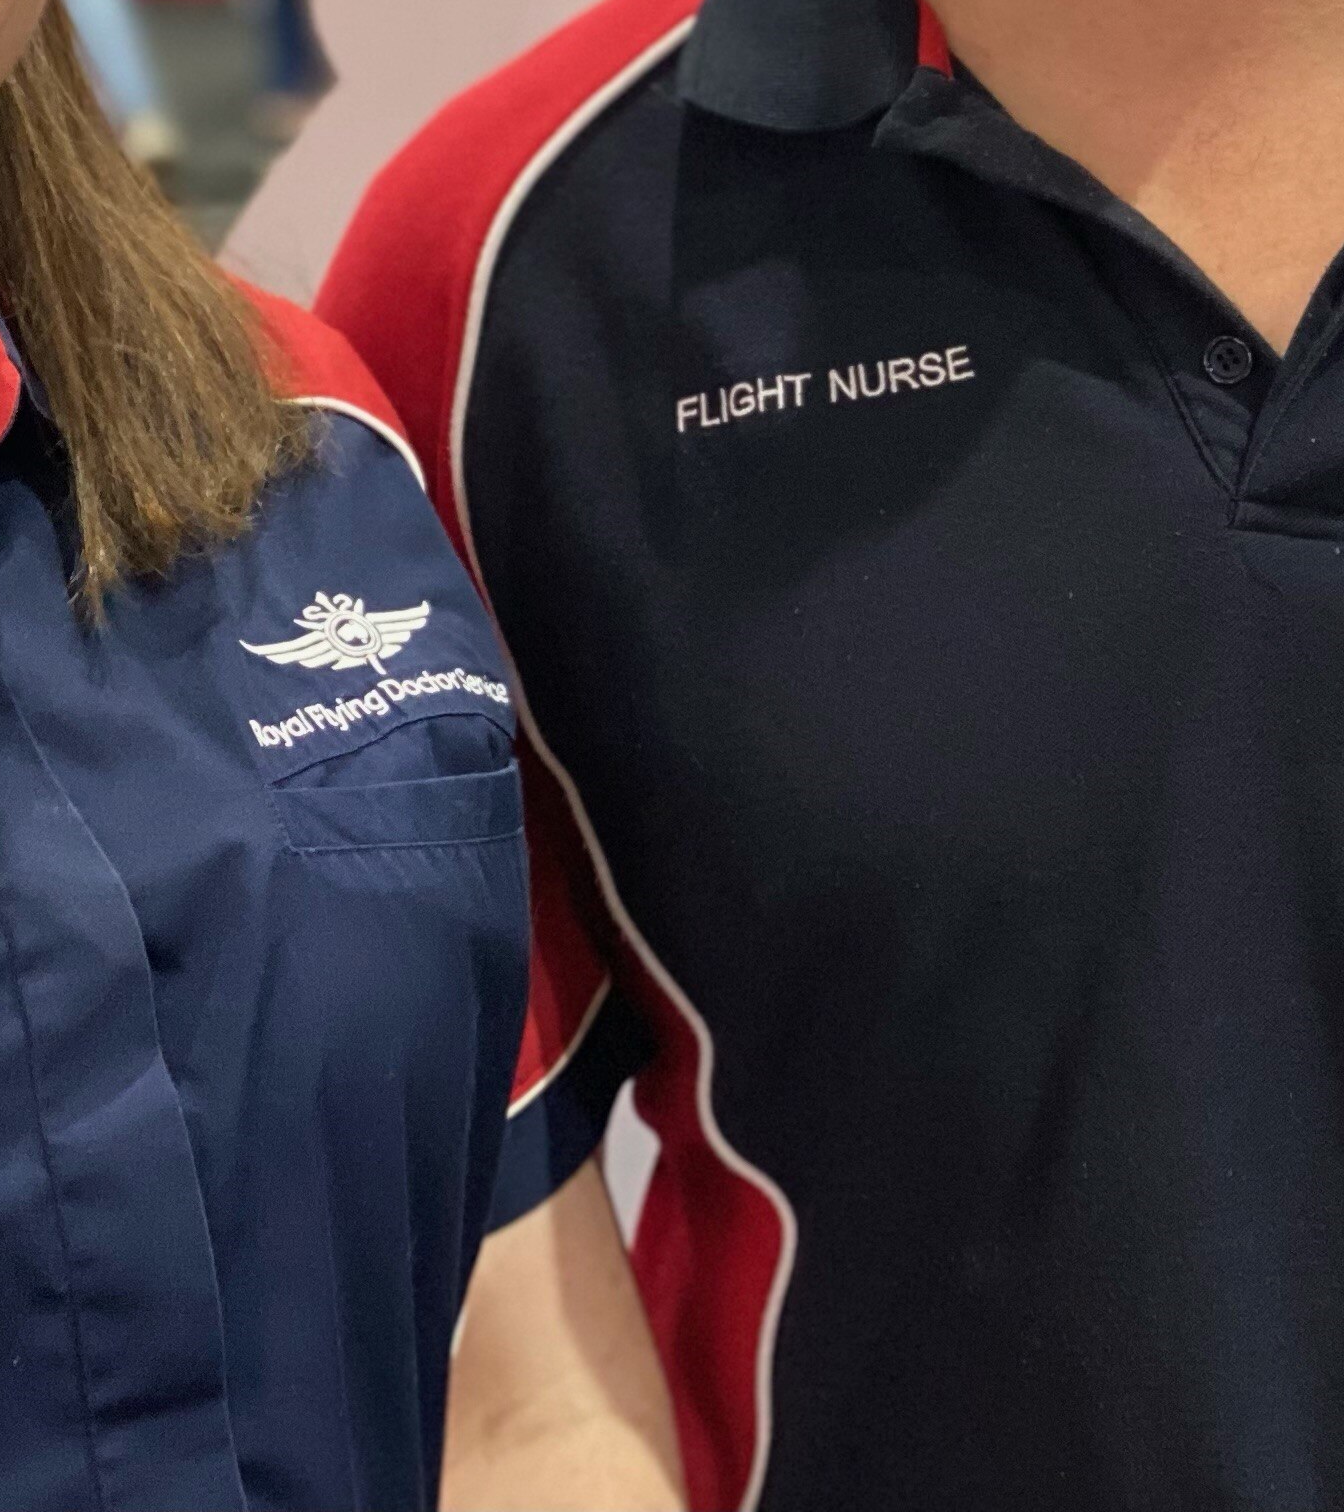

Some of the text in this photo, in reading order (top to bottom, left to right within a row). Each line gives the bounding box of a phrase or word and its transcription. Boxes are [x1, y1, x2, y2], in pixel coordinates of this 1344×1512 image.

[676, 345, 976, 434] FLIGHT NURSE
[249, 708, 315, 748] Royal
[304, 689, 390, 731] Flying
[377, 670, 461, 702] Doctor
